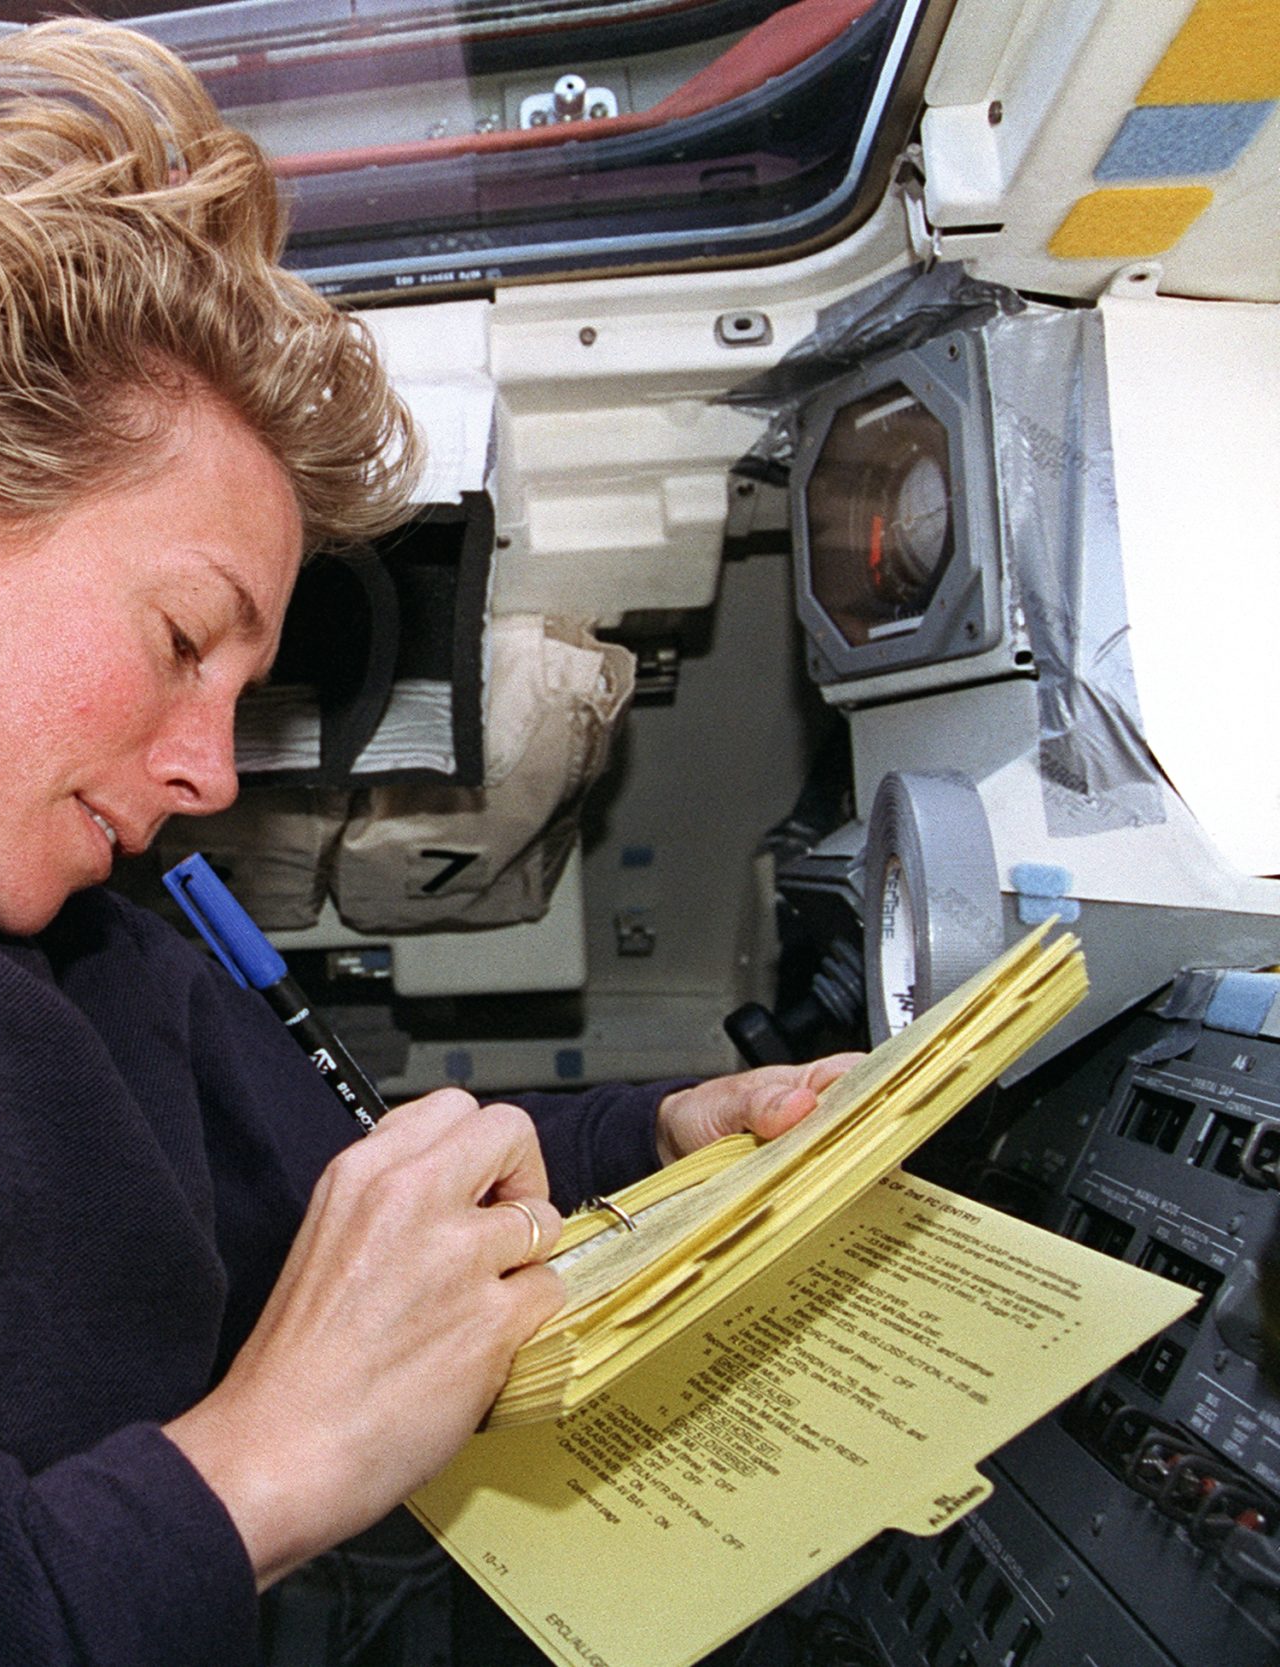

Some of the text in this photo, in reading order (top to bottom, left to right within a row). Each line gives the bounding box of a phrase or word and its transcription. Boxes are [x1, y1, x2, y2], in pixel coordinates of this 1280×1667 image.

[336, 1081, 355, 1101] 318
[889, 1182, 980, 1221] OF 2nd FC (ENTRY)
[911, 1212, 1081, 1290] Perform PWRDN ASAP while continuing
[924, 1263, 961, 1282] duration
[972, 1274, 1016, 1295] sustained
[834, 1268, 940, 1321] MSTR PWR OFF
[900, 1265, 1008, 1317] situations Purge
[804, 1301, 906, 1358] Perform BUS LOSS
[880, 1318, 912, 1335] contact
[896, 1312, 922, 1328] Buses
[794, 1347, 825, 1368] PWRDN
[799, 1324, 916, 1388] CIRC PUMP OFF
[767, 1389, 793, 1407] ALIGN
[828, 1381, 851, 1395] INST
[685, 1409, 733, 1443] NAV DELTA
[731, 1425, 759, 1447] HORIZ
[736, 1382, 868, 1465] OPER RESET
[571, 1433, 645, 1492] CAB ON
[594, 1419, 664, 1471] MLS OFF
[605, 1412, 703, 1485] RADAR (two) OFF
[617, 1405, 736, 1492] TACAN MODE (three) OFF
[705, 1440, 750, 1474] OVERRIDE
[627, 1494, 669, 1529] BAY ON
[650, 1479, 744, 1549] HTR SPLY OFF
[483, 1552, 508, 1576] 10-71
